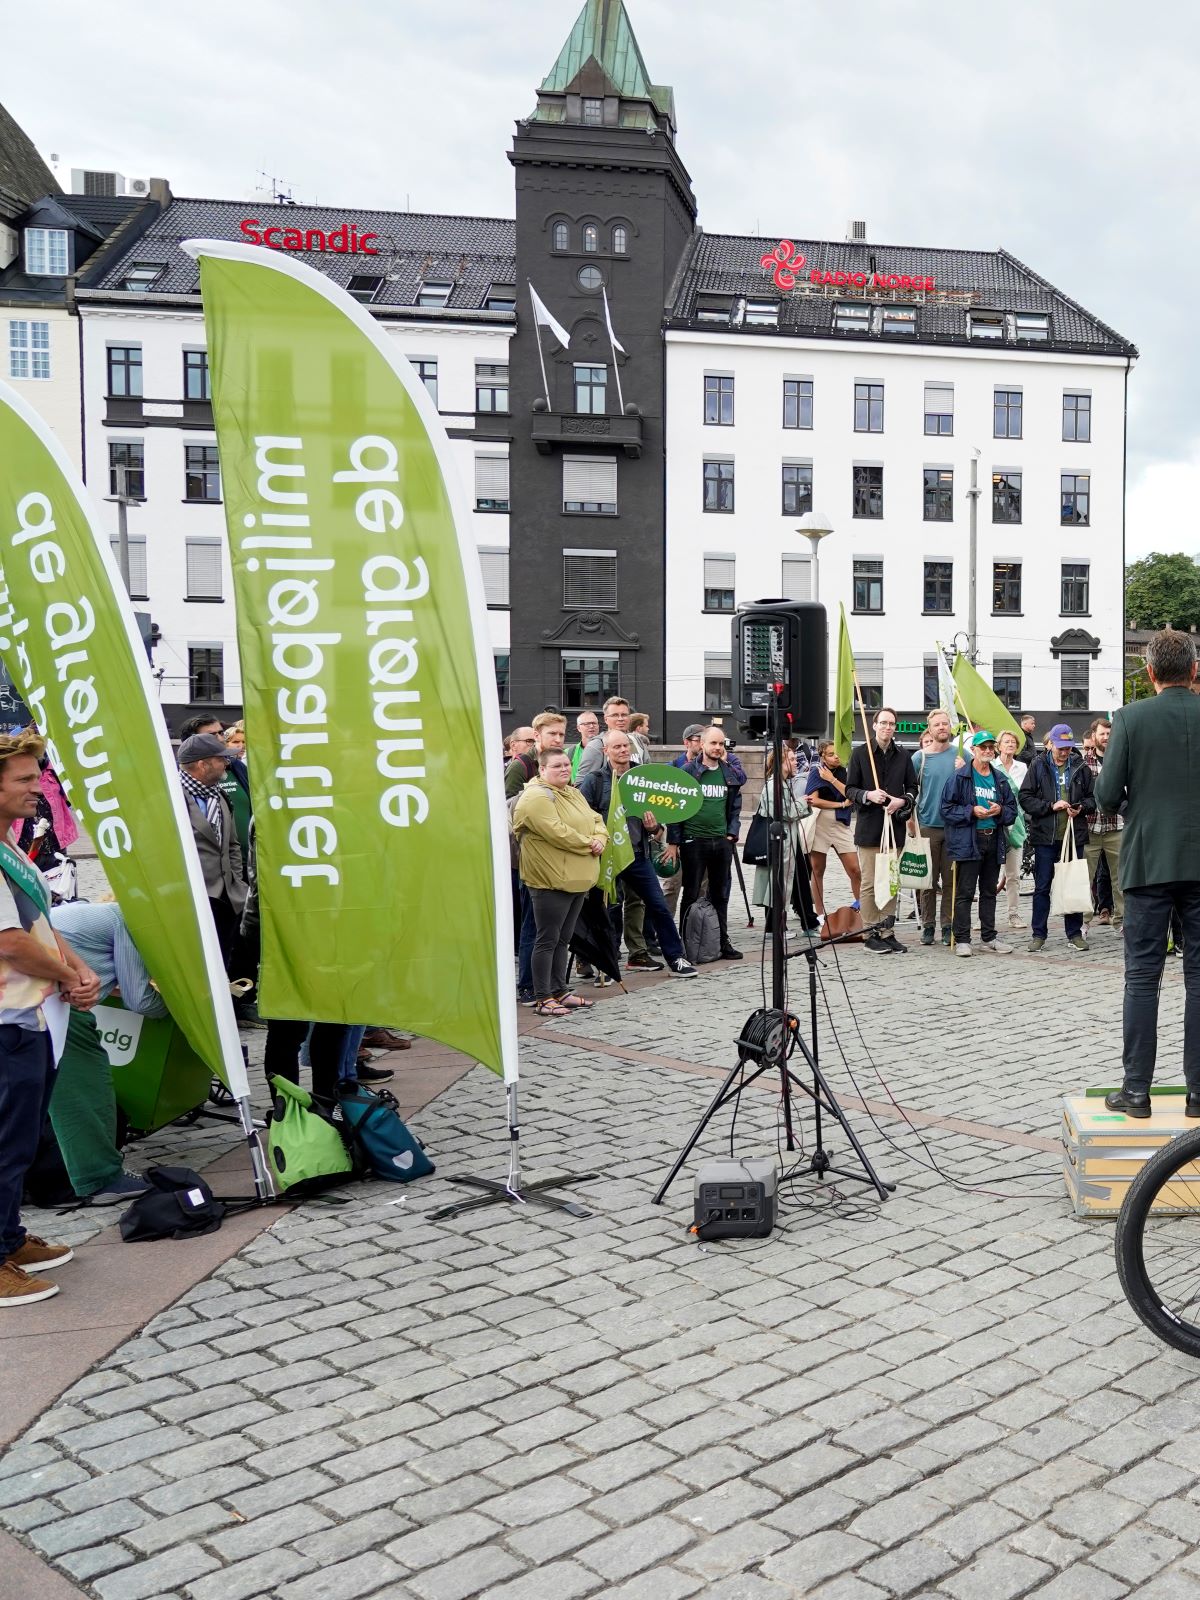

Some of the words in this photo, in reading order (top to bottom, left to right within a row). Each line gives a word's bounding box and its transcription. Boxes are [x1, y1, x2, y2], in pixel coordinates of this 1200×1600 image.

[240, 219, 378, 254] Scandic
[810, 269, 867, 287] RADIO
[873, 272, 936, 291] NORGE
[626, 774, 698, 796] Månedskort
[633, 792, 646, 803] til
